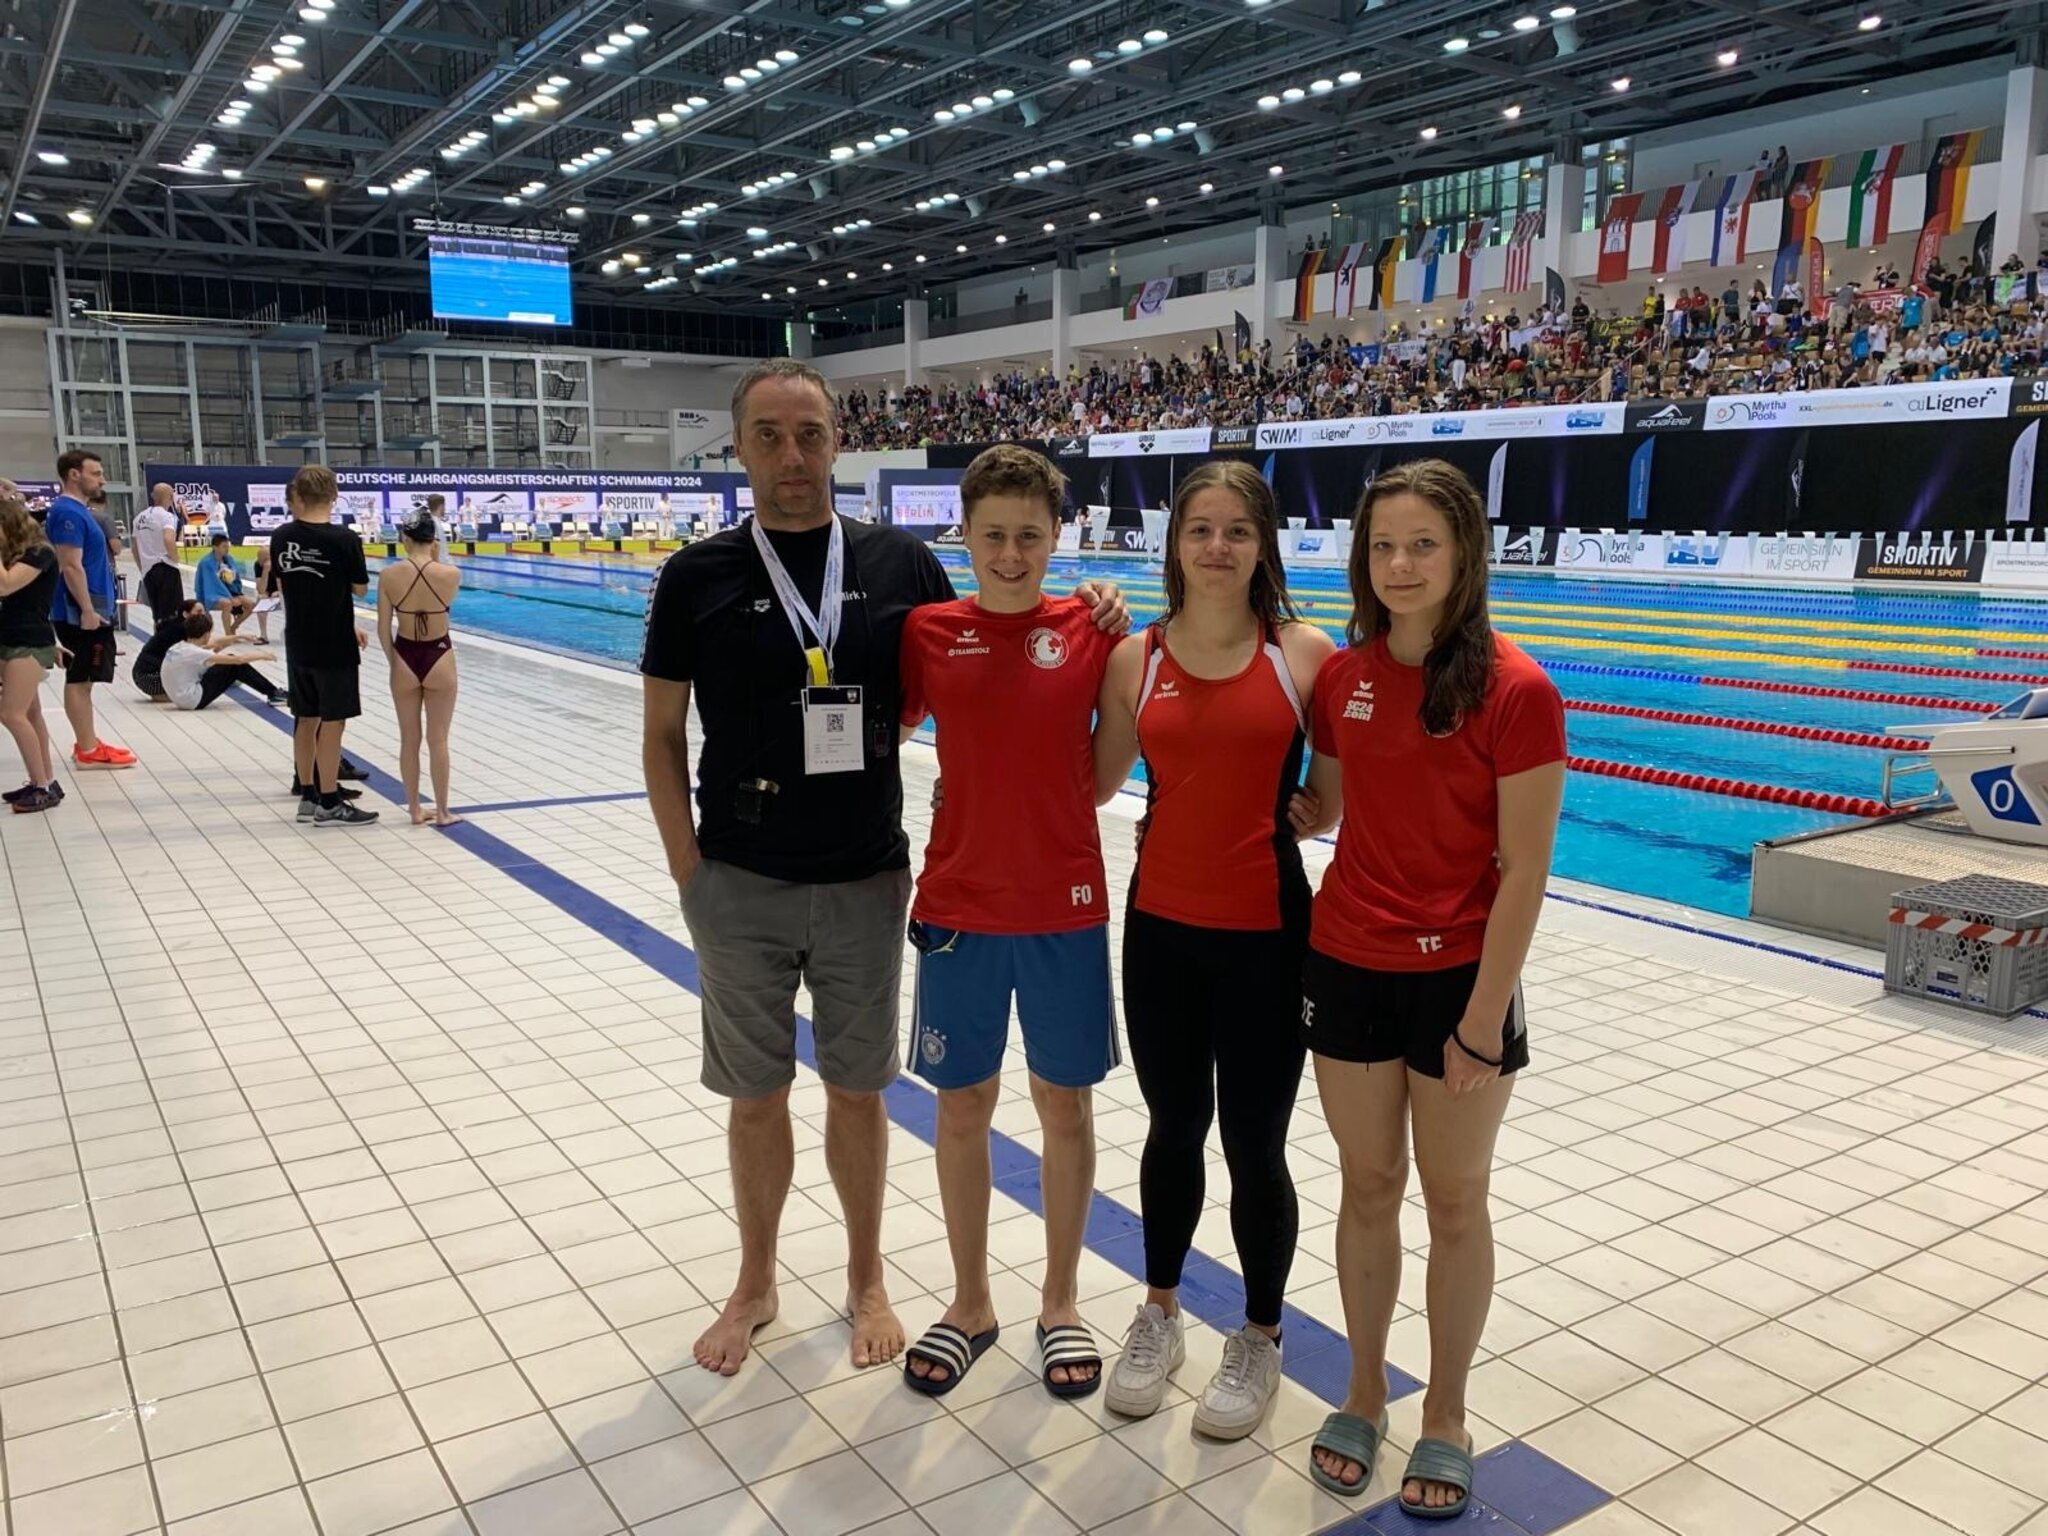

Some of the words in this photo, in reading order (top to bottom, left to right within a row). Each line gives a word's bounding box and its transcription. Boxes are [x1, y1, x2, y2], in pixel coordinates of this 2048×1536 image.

[1752, 401, 1787, 412] Myrtha
[1752, 411, 1777, 420] Pools
[1636, 416, 1693, 428] aquafeel
[1218, 428, 1249, 442] SPORTIV
[336, 473, 406, 484] DEUTSCHE
[407, 473, 598, 486] JAHRGANGSMEISTERSCHAFTEN
[599, 475, 672, 486] SCHWIMMEN
[673, 476, 702, 487] 2024
[176, 483, 210, 495] DJM
[609, 496, 655, 510] SPORTIV
[1784, 559, 1831, 572] SPORT
[1867, 566, 1922, 576] GEMEINSINN
[1937, 569, 1969, 577] SPORT
[1154, 690, 1180, 700] erima
[1989, 779, 2015, 813] 0
